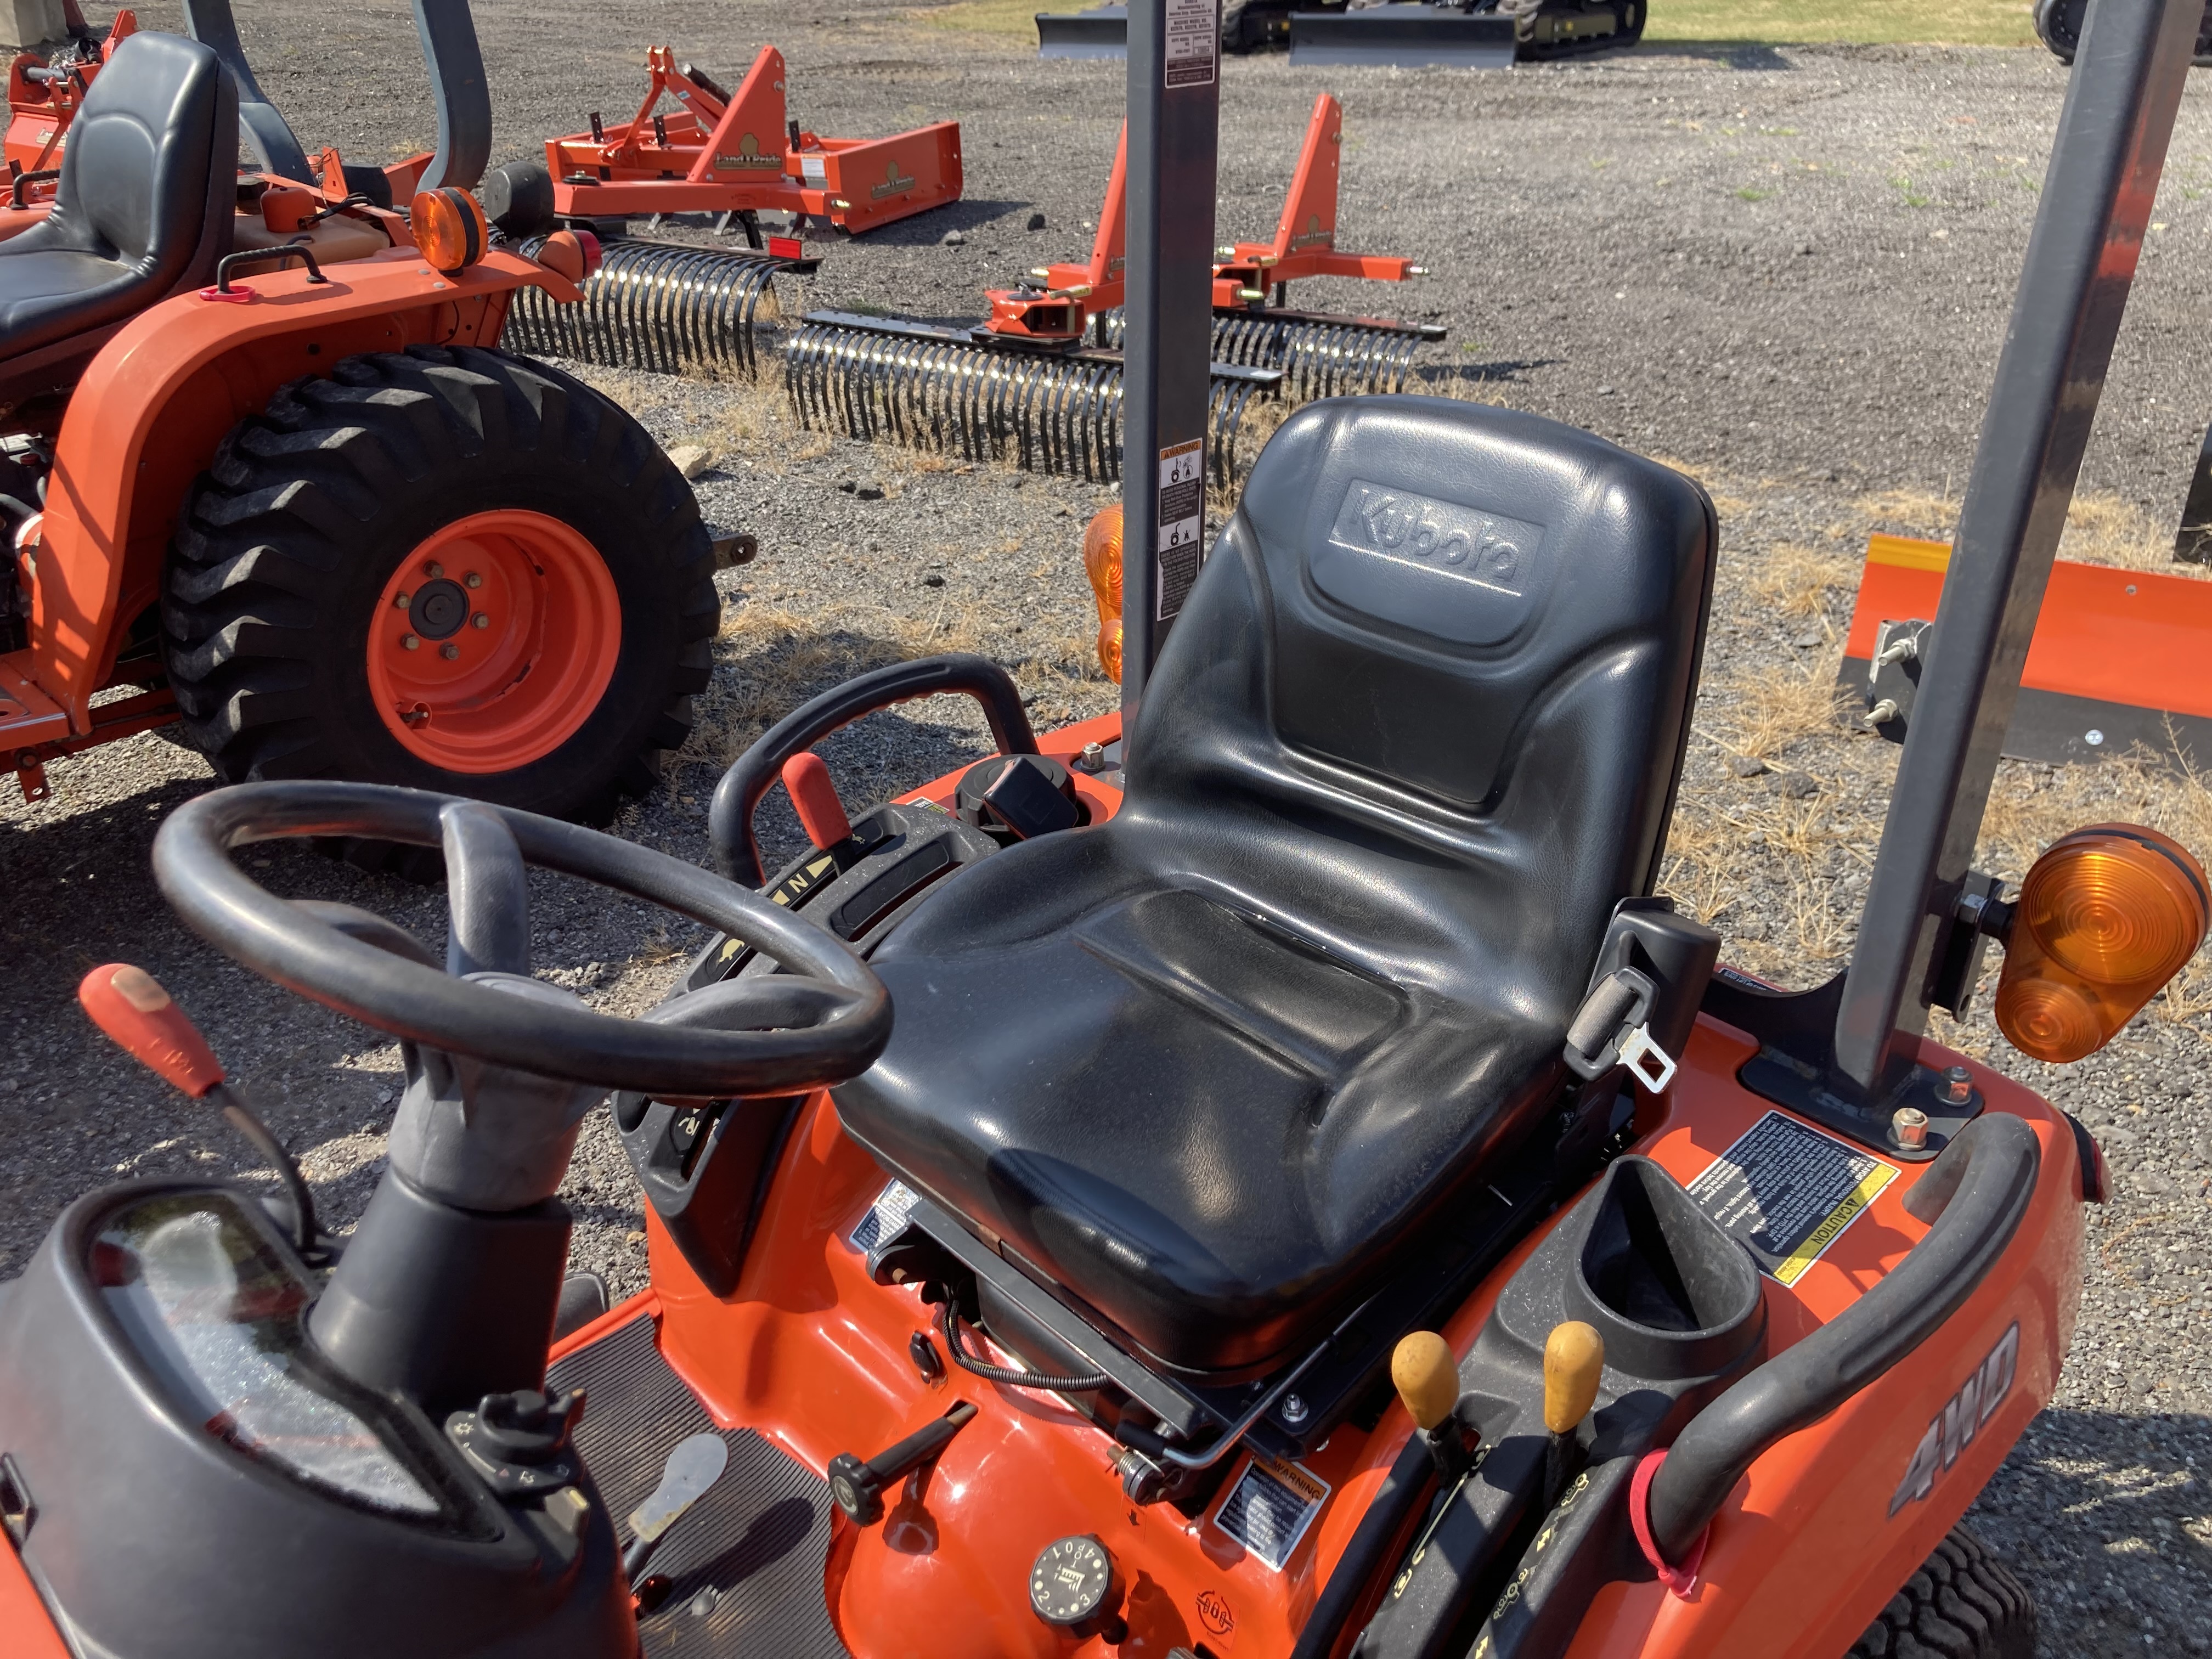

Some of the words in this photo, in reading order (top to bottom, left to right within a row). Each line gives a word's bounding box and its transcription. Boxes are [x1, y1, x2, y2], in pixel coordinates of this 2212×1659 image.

[1167, 442, 1198, 457] WARNING
[1350, 489, 1520, 581] Kubota
[788, 873, 809, 894] N
[1725, 1161, 1737, 1171] and
[1851, 1161, 1865, 1172] Read
[1865, 1160, 1877, 1169] TO
[1700, 1173, 1716, 1186] before
[1713, 1167, 1731, 1182] remove
[1853, 1165, 1872, 1181] AVOID
[1701, 1184, 1714, 1194] key.
[1708, 1179, 1719, 1187] the
[1713, 1183, 1725, 1191] the
[1689, 1183, 1706, 1197] workin
[1735, 1186, 1752, 1199] hazard
[1832, 1178, 1860, 1202] PERSONAL
[1725, 1196, 1741, 1209] lights,
[1817, 1199, 1839, 1217] INJURY:
[1733, 1205, 1752, 1220] moving
[1724, 1217, 1740, 1229] parts.
[1757, 1215, 1771, 1226] have
[1776, 1217, 1789, 1227] PTO
[1809, 1205, 1854, 1245] CAUTION
[1748, 1223, 1763, 1234] them
[1765, 1228, 1779, 1239] OFF.
[1886, 1321, 2020, 1520] 4WD
[1274, 1460, 1321, 1499] WARNING
[1251, 1498, 1268, 1512] arrester
[1256, 1511, 1272, 1525] should
[1244, 1522, 1261, 1538] relating
[1263, 1536, 1272, 1545] fire
[1258, 1522, 1269, 1532] laws
[1052, 1547, 1061, 1560] 1
[1065, 1542, 1073, 1554] 0
[1085, 1548, 1095, 1559] 4
[1037, 1590, 1050, 1603] 2
[1080, 1593, 1091, 1606] 3
